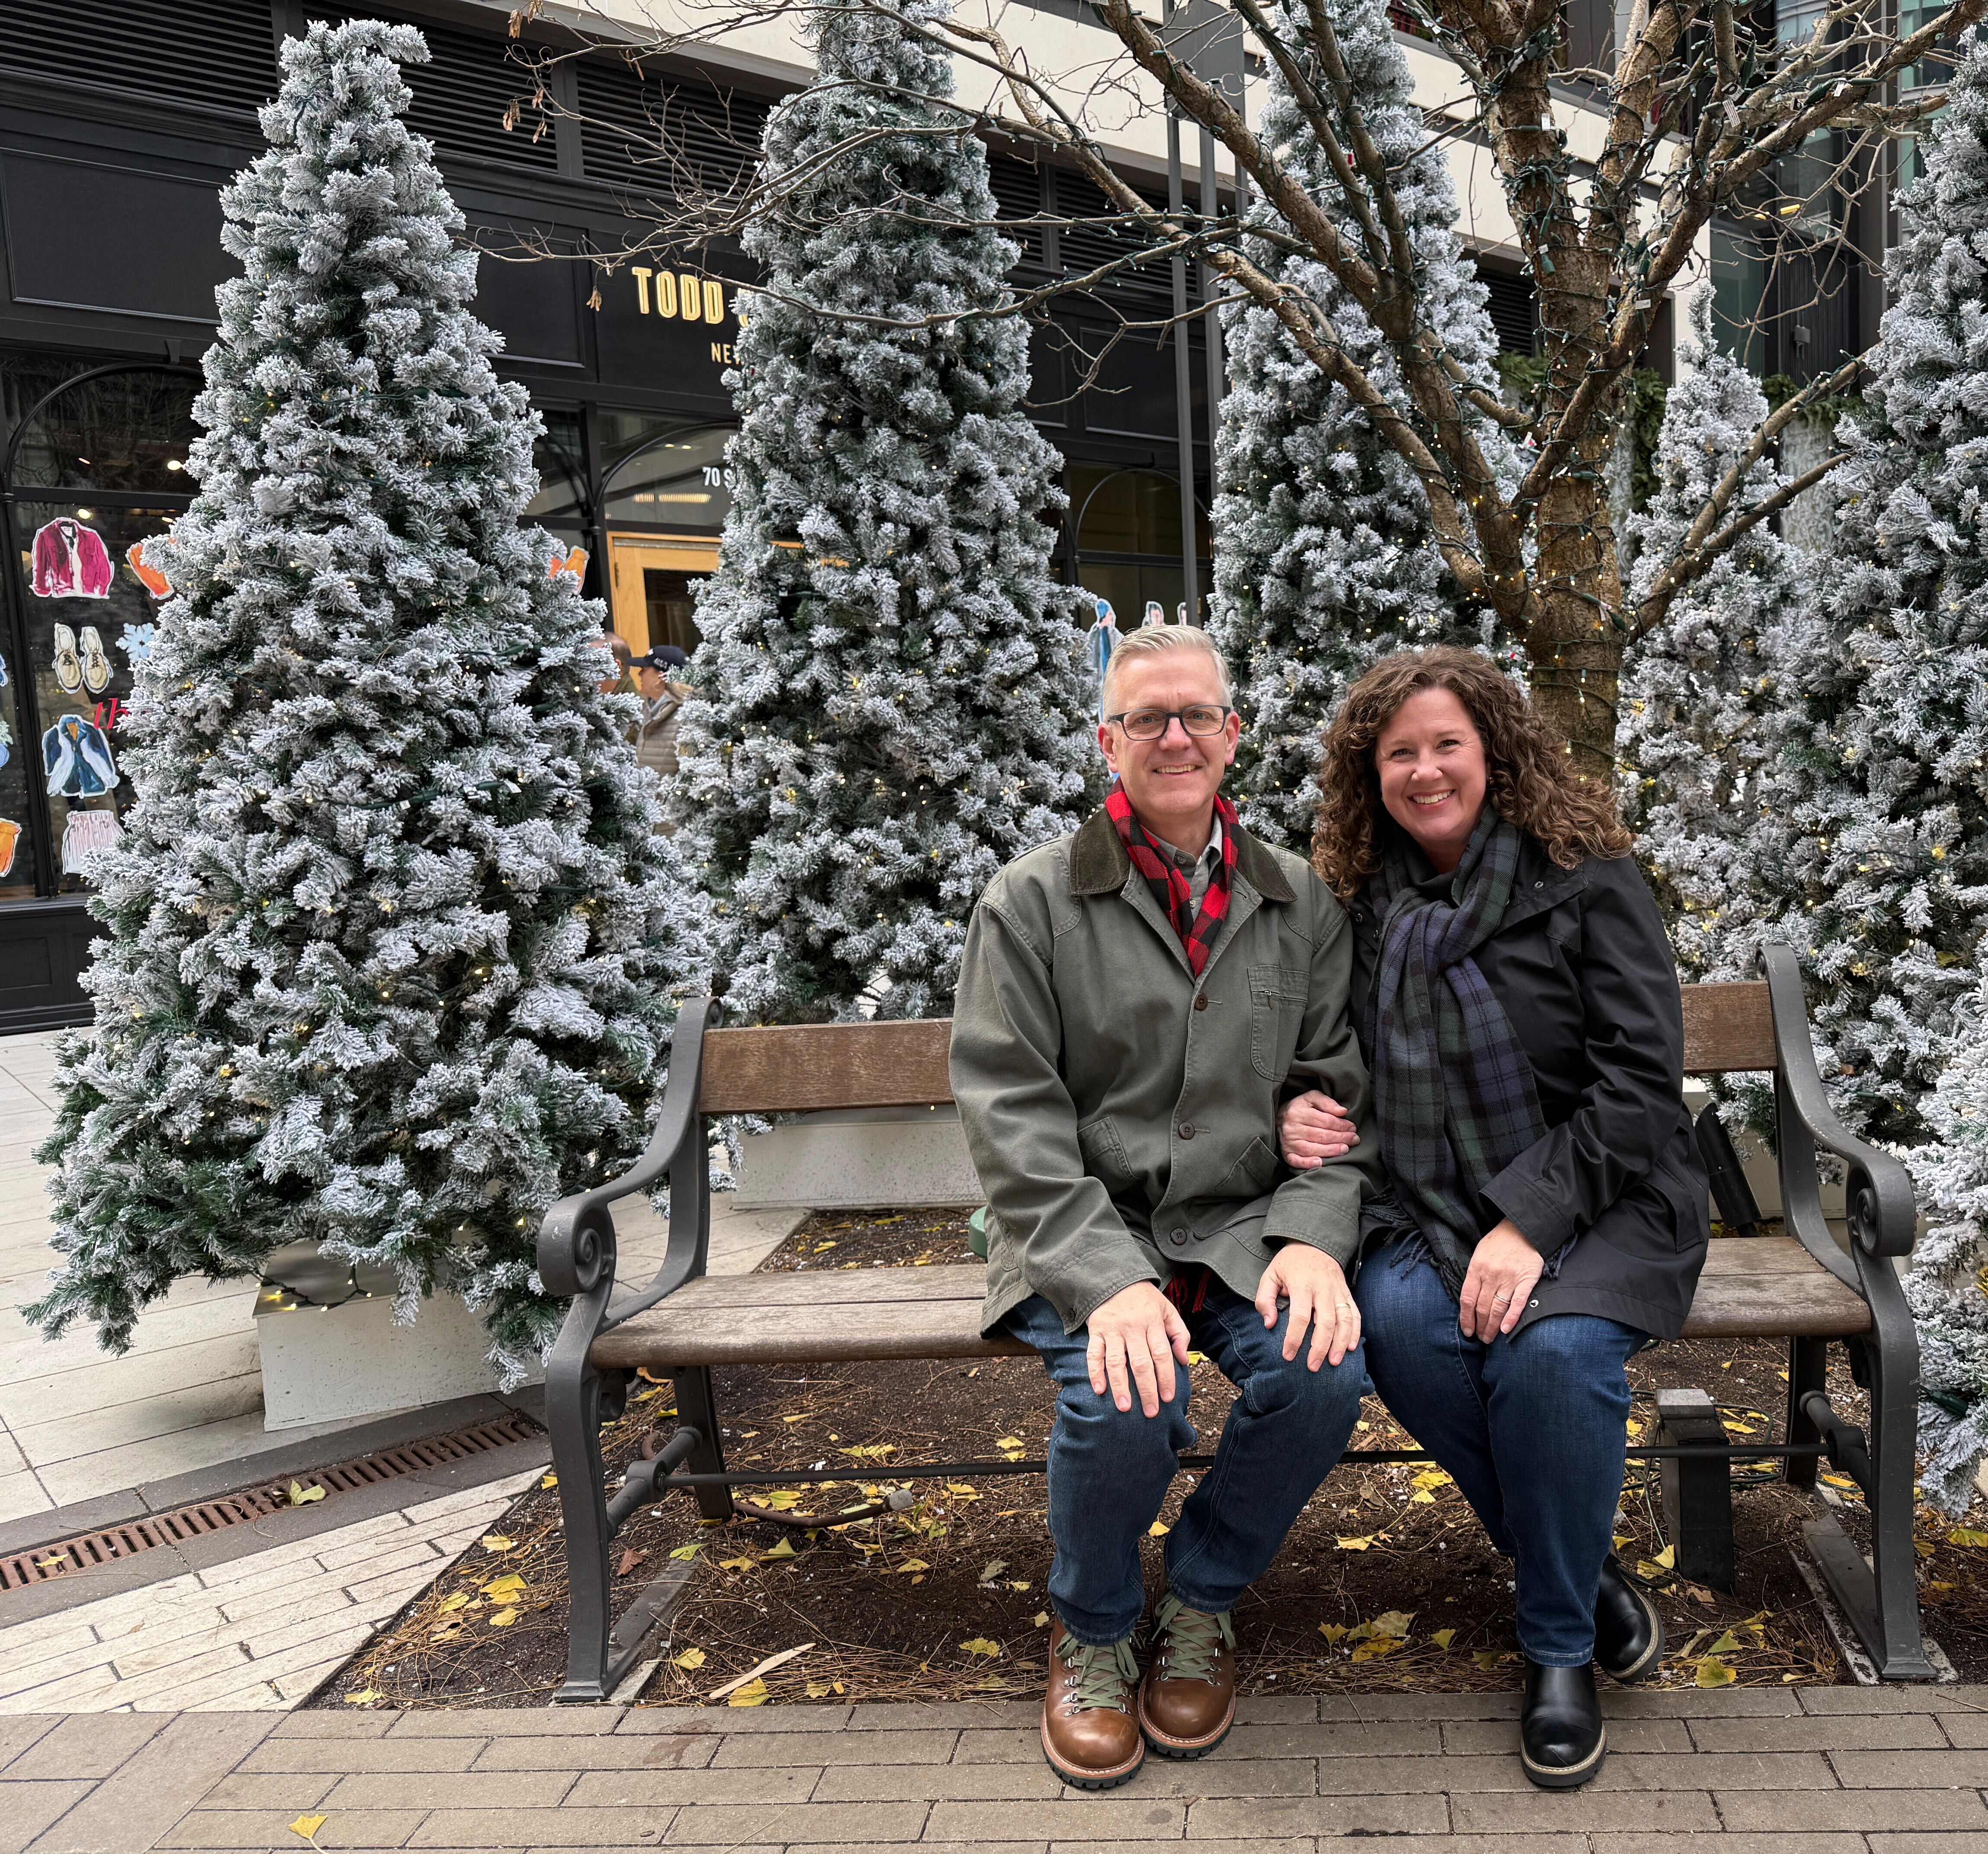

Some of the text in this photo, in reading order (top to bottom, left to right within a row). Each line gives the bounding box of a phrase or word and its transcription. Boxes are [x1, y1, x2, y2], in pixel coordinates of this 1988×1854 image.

[632, 266, 724, 324] TODD
[702, 466, 721, 487] 70
[93, 698, 145, 730] th
